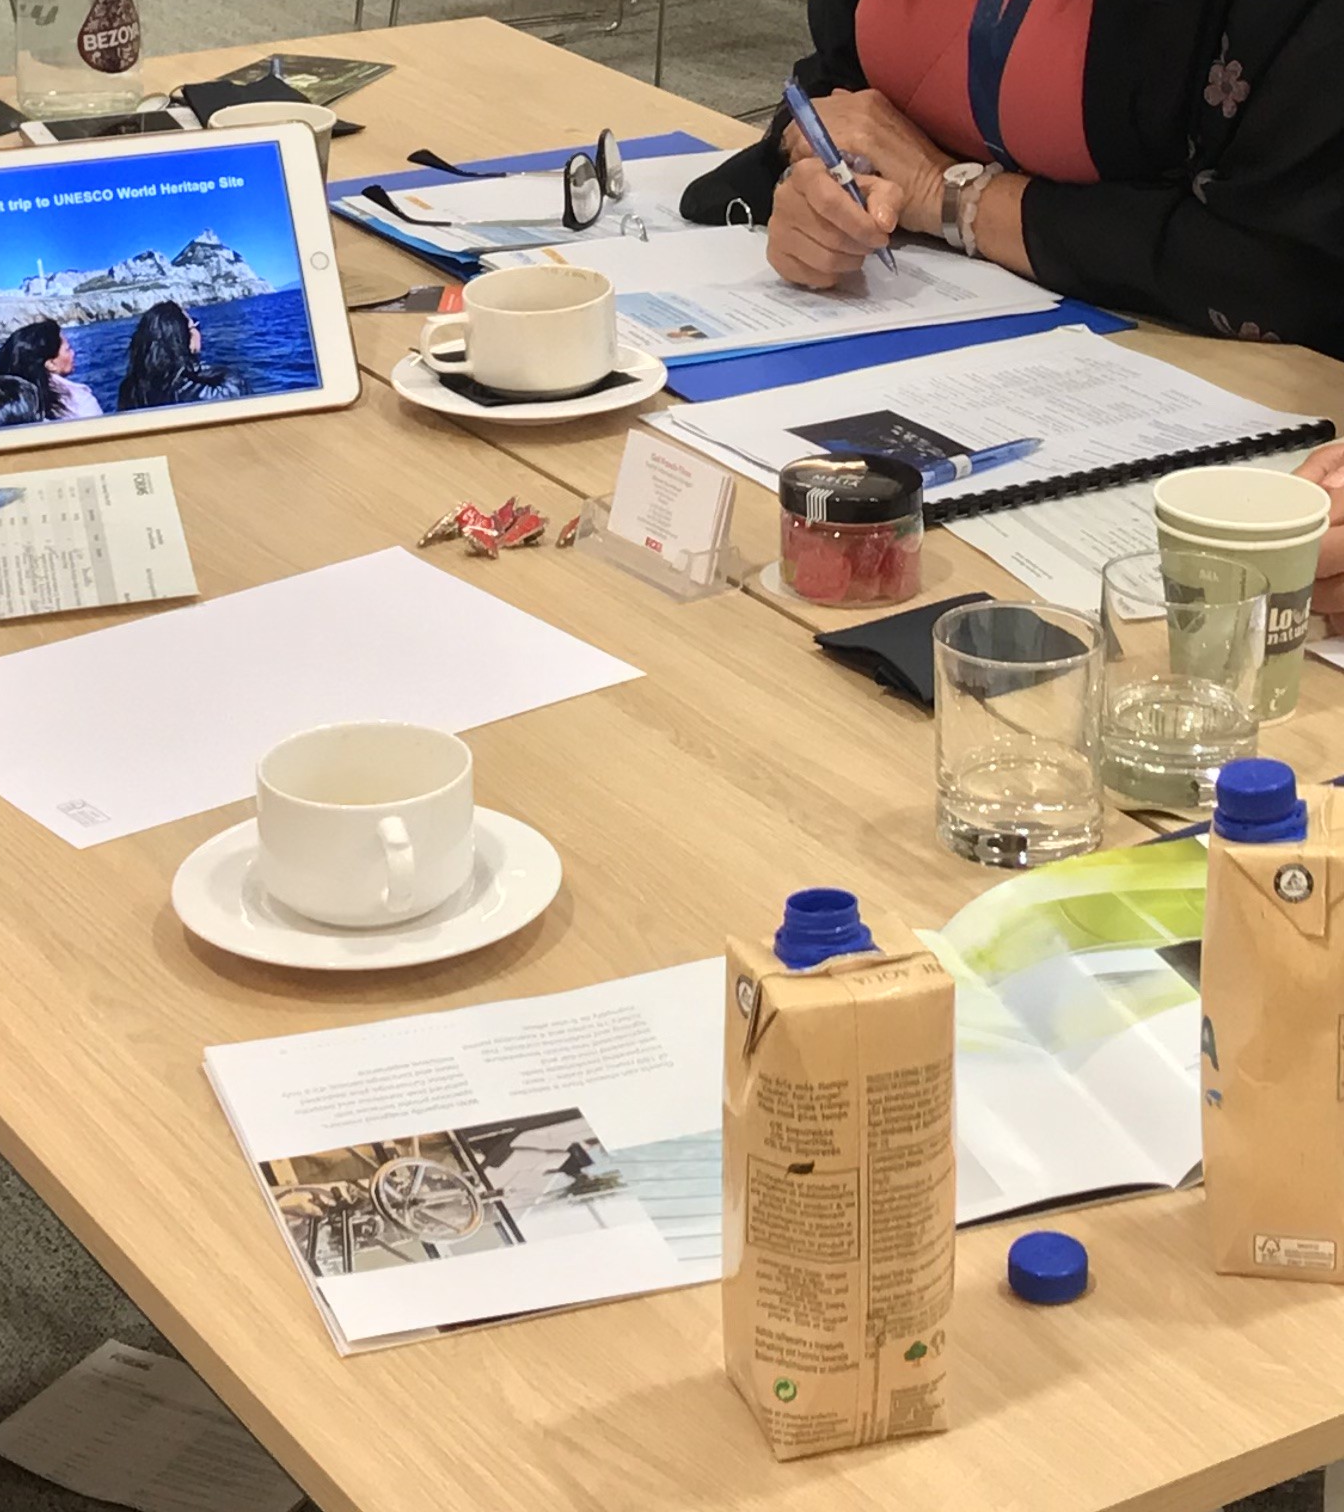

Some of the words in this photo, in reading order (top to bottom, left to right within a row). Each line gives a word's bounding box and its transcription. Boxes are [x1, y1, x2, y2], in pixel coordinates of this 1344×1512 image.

[8, 198, 32, 214] trip
[35, 196, 51, 208] to
[53, 188, 114, 207] UNESCO
[116, 185, 158, 201] World
[160, 178, 216, 196] Heritage
[218, 176, 246, 189] Site
